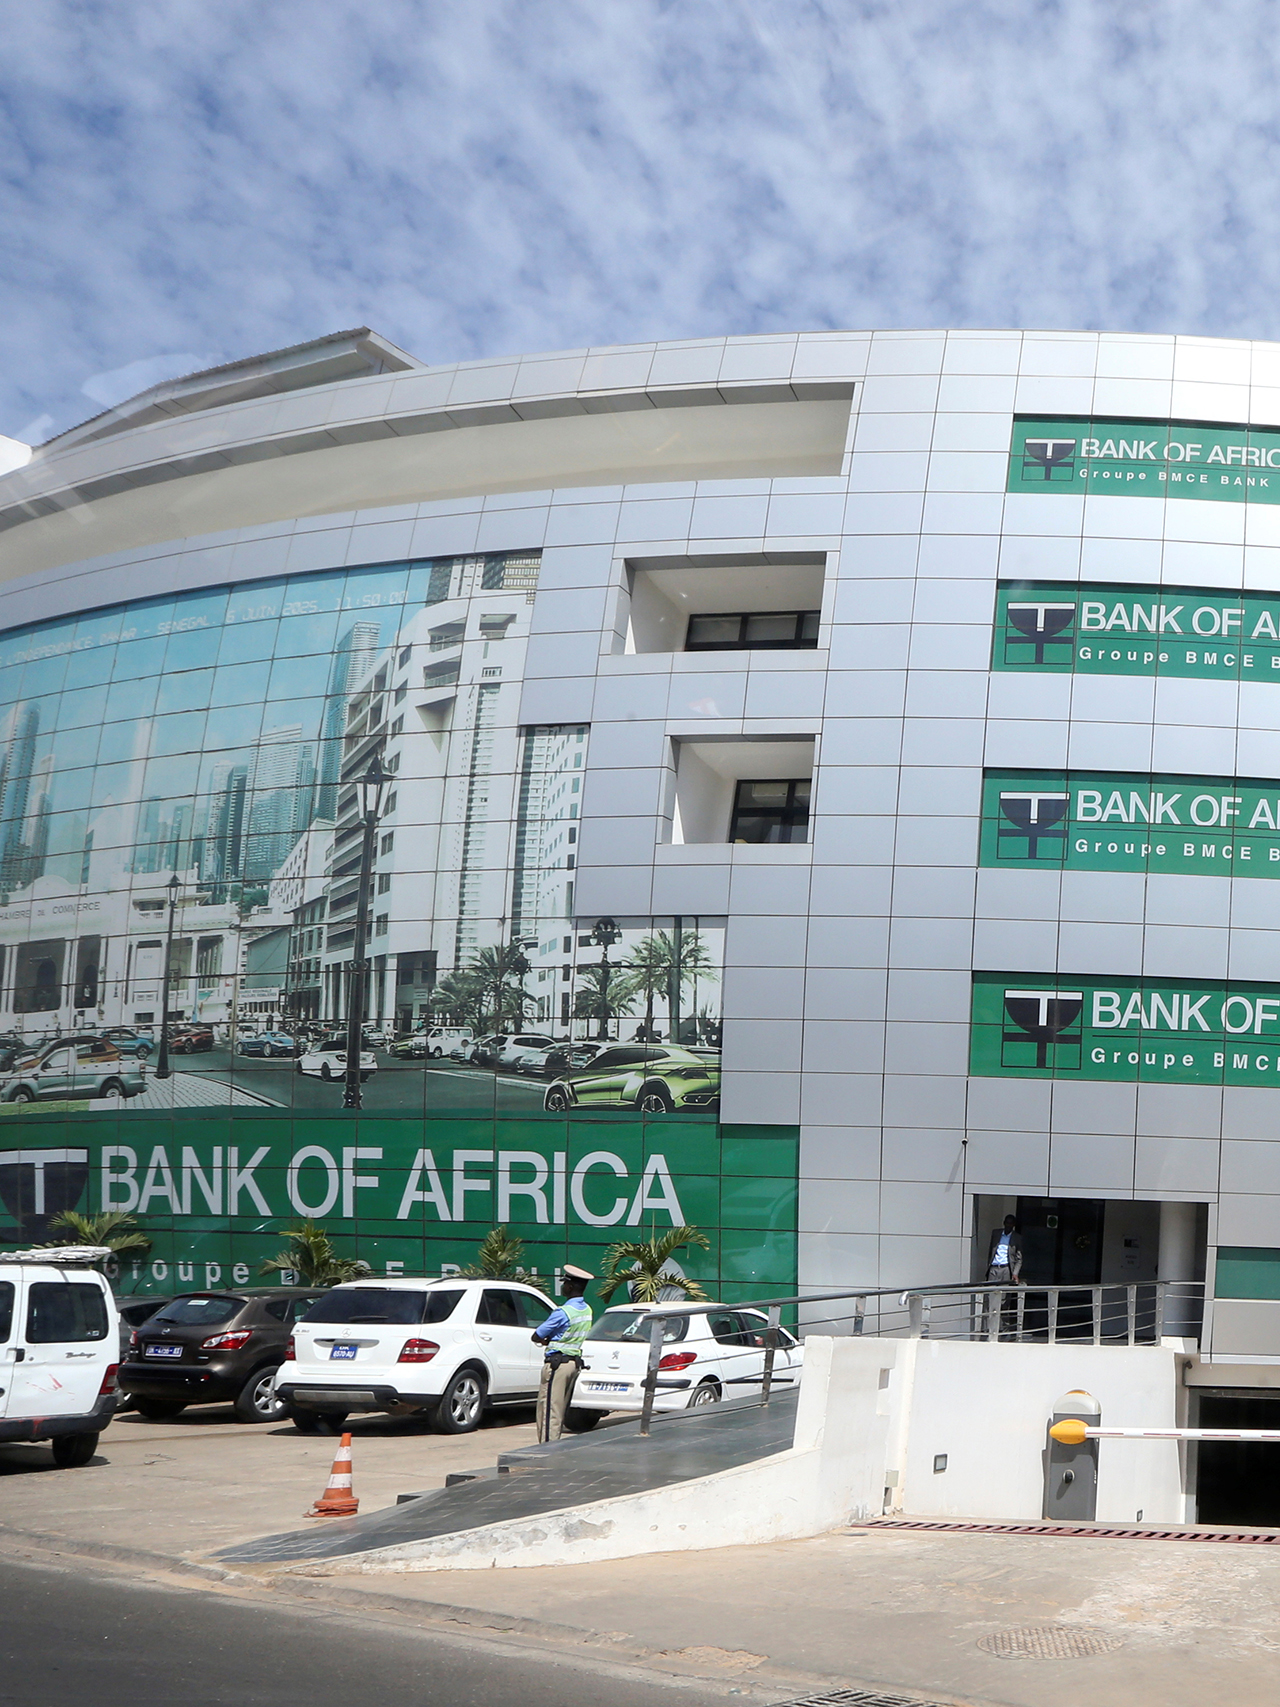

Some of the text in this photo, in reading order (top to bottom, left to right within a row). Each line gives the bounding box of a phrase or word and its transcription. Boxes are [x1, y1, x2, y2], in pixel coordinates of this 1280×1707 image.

[1080, 438, 1158, 461] BANK
[1163, 441, 1203, 463] OF
[1079, 468, 1270, 488] Groupe BMCE BANK
[1081, 601, 1188, 636] BANK
[1191, 605, 1246, 638] OF
[1079, 646, 1170, 664] Groupe
[1185, 651, 1255, 668] BMCE
[1076, 789, 1182, 825] BANK
[1190, 793, 1243, 827] OF
[1075, 838, 1167, 858] Groupe
[1183, 842, 1252, 861] BMCE
[1092, 990, 1212, 1032] BANK
[1220, 995, 1280, 1035] OF
[1090, 1047, 1195, 1069] Groupe
[100, 1144, 688, 1228] BANK OF AFRICA
[102, 1252, 250, 1289] Groupe
